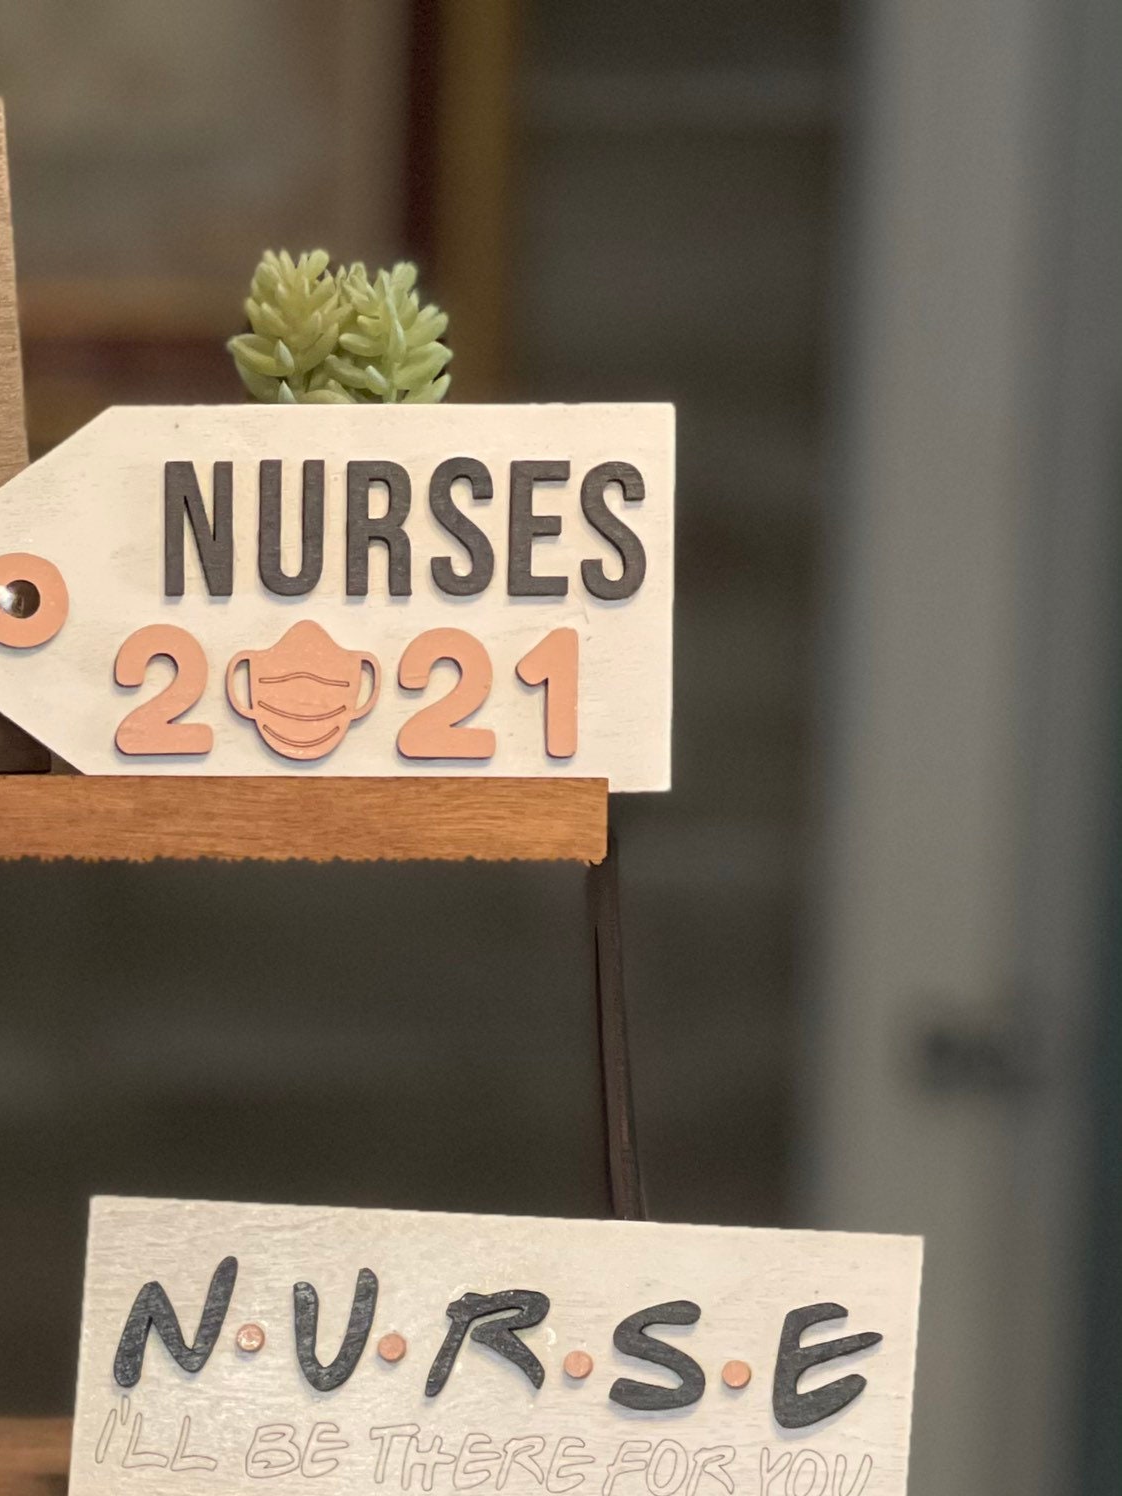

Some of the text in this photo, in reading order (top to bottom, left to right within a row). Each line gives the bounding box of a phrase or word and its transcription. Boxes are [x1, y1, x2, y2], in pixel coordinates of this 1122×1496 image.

[163, 457, 647, 600] NURSES
[95, 1397, 218, 1472] I'LL
[245, 1421, 349, 1479] BE
[369, 1423, 596, 1494] THERE
